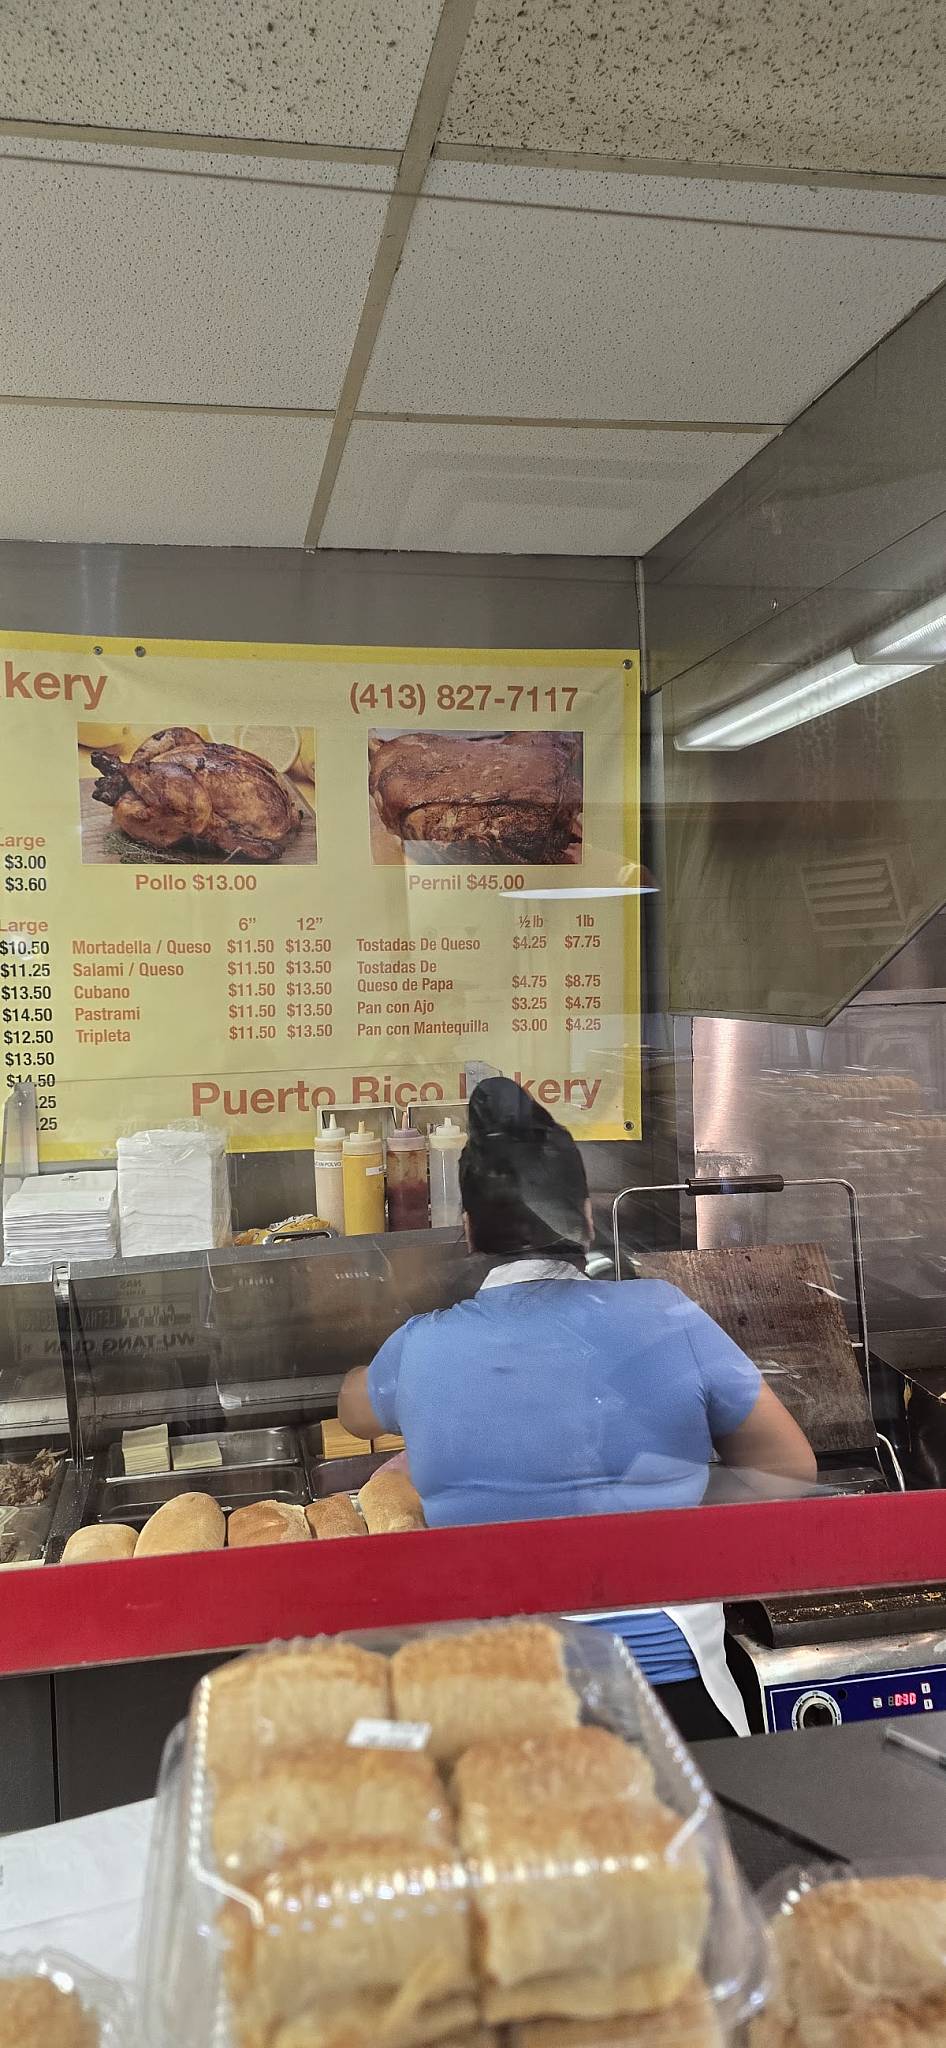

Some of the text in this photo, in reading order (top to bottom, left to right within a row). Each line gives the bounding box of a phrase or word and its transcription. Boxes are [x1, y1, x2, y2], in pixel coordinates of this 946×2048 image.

[0, 661, 108, 710] kery
[349, 681, 579, 716] (413) 827-7117
[4, 853, 47, 871] $3.00
[5, 875, 47, 893] $3.60
[135, 873, 257, 892] Pollo $13.00
[406, 873, 526, 891] Pernil $45.00
[0, 940, 50, 956] $10.50
[72, 938, 332, 955] Mortadella / Queso $11.50 $13.50
[355, 934, 601, 952] Tostadas De Queso $4.25 $7.75
[0, 962, 51, 979] $11.25
[72, 959, 332, 977] Salami / Queso $11.50 $13.50
[356, 959, 437, 975] Tostadas De
[73, 981, 333, 1000] Cubano $11.50 $13.50
[357, 973, 601, 993] Queso de Papa $4.75 $8.75
[1, 985, 52, 1001] $13.50
[75, 1002, 333, 1022] Pastrami $11.50 $13.50
[357, 995, 601, 1016] Pan con Ajo $3.25 $4.75
[2, 1007, 53, 1023] $14.50
[75, 1023, 333, 1045] Tripleta $11.50 $13.50
[357, 1016, 602, 1037] Pan con Mantequilla $3.00 $4.25
[3, 1030, 54, 1046] $12.50
[5, 1051, 55, 1067] $13.50
[192, 1071, 602, 1116] Puerto Rico kery
